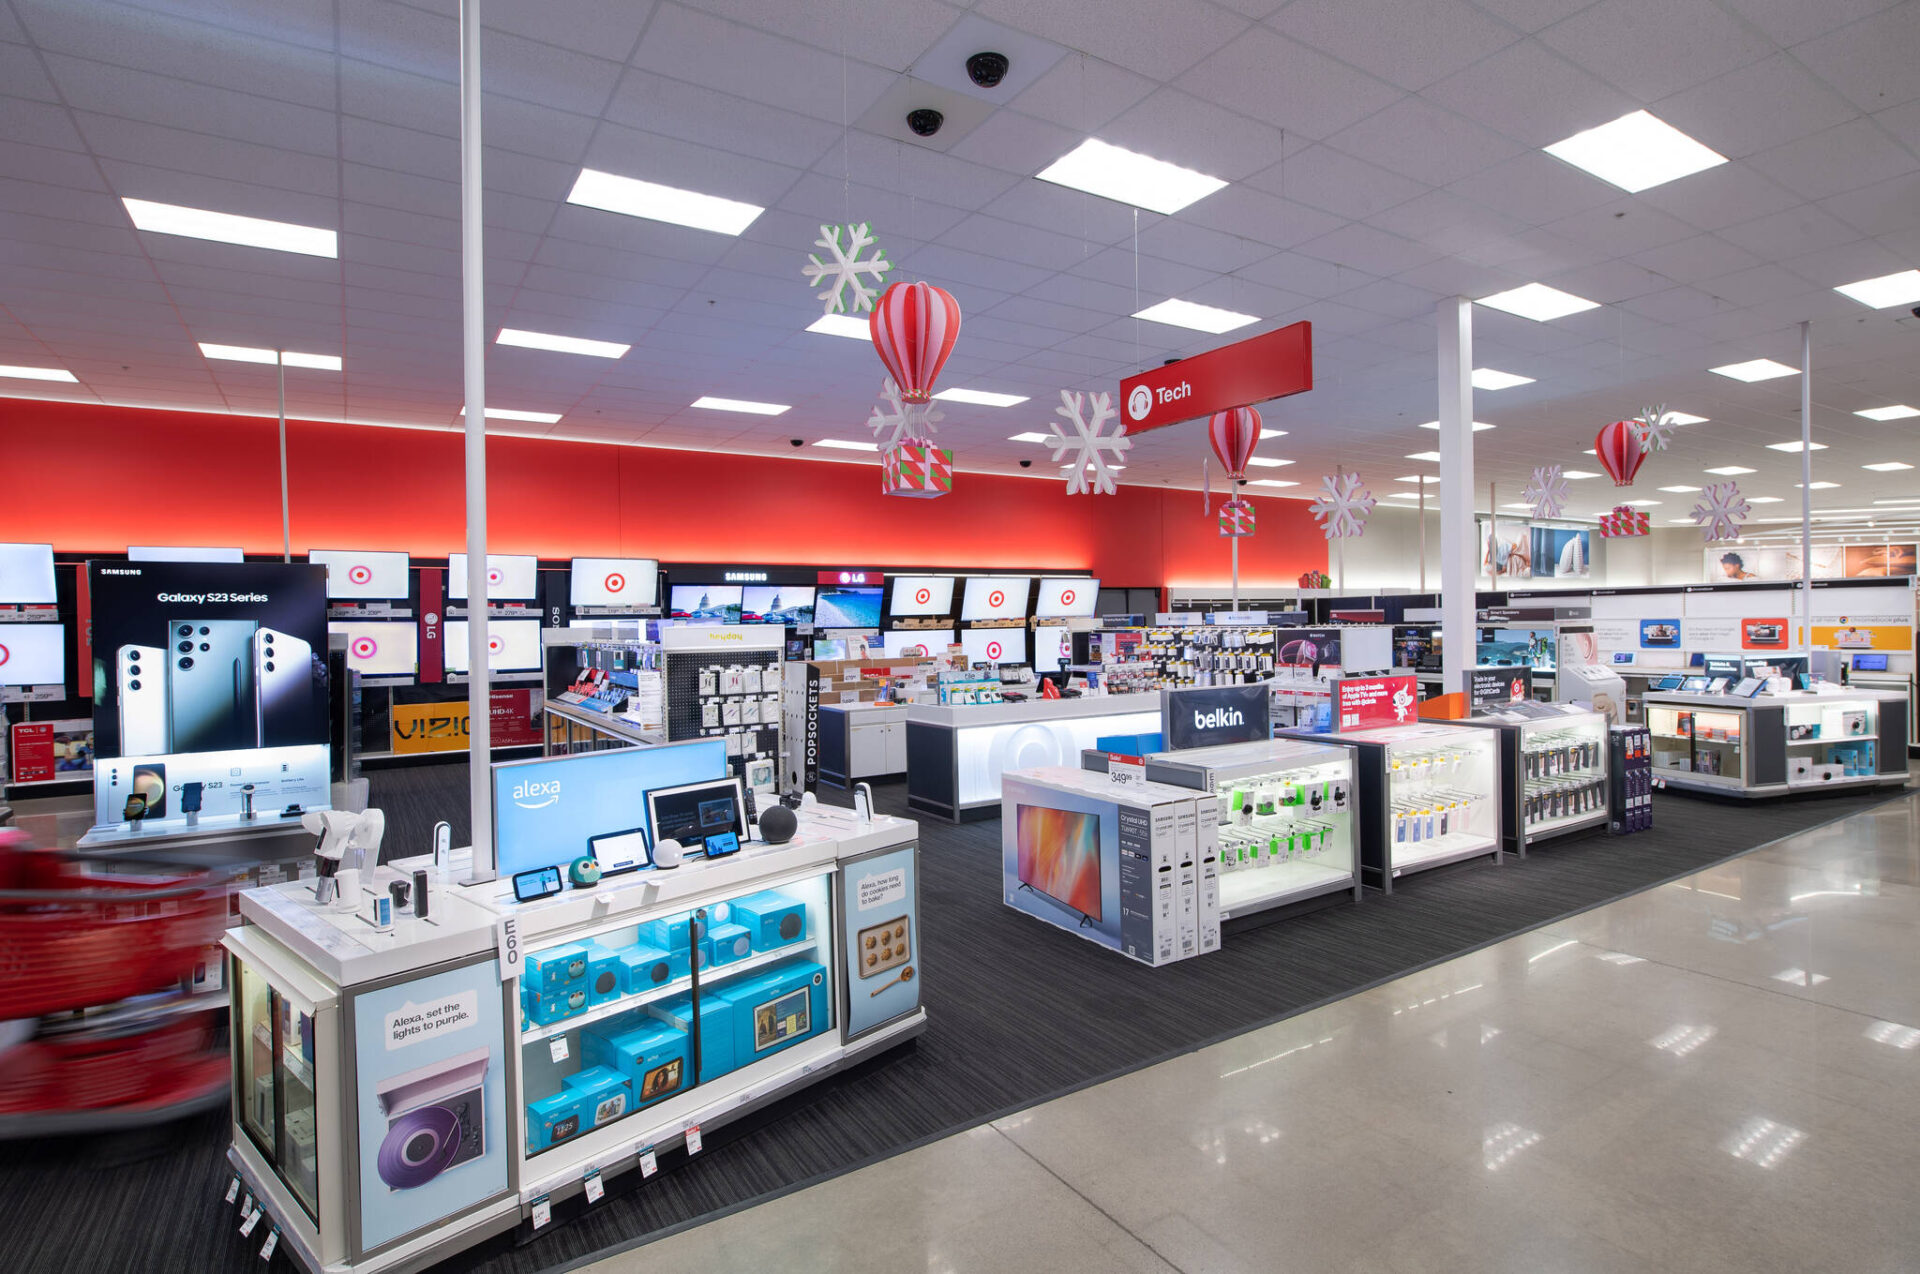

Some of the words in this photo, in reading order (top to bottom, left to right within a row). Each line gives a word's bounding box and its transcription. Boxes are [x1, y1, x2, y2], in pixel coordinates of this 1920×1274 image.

[1156, 381, 1191, 405] Tech
[100, 568, 142, 576] SAMSUNG
[725, 573, 767, 582] SAMSUNG
[852, 573, 865, 583] LG
[157, 592, 206, 604] Galaxy
[207, 593, 228, 603] S23
[230, 592, 268, 603] Series
[426, 626, 436, 639] LG
[807, 679, 818, 765] POPSOCKETS
[1194, 706, 1243, 730] belkin
[208, 781, 223, 789] S23
[512, 778, 561, 800] alexa
[1120, 814, 1138, 825] Crystal
[1138, 817, 1148, 827] UHD
[889, 875, 899, 883] long
[870, 886, 889, 896] cookies
[889, 881, 901, 890] need
[868, 893, 884, 904] bake?
[1122, 907, 1130, 916] 17
[504, 919, 518, 964] E60
[392, 1014, 424, 1029] Alexa,
[426, 1007, 442, 1019] set
[444, 1003, 460, 1014] the
[393, 1025, 421, 1041] lights
[423, 1021, 433, 1031] to
[436, 1012, 469, 1029] purple.
